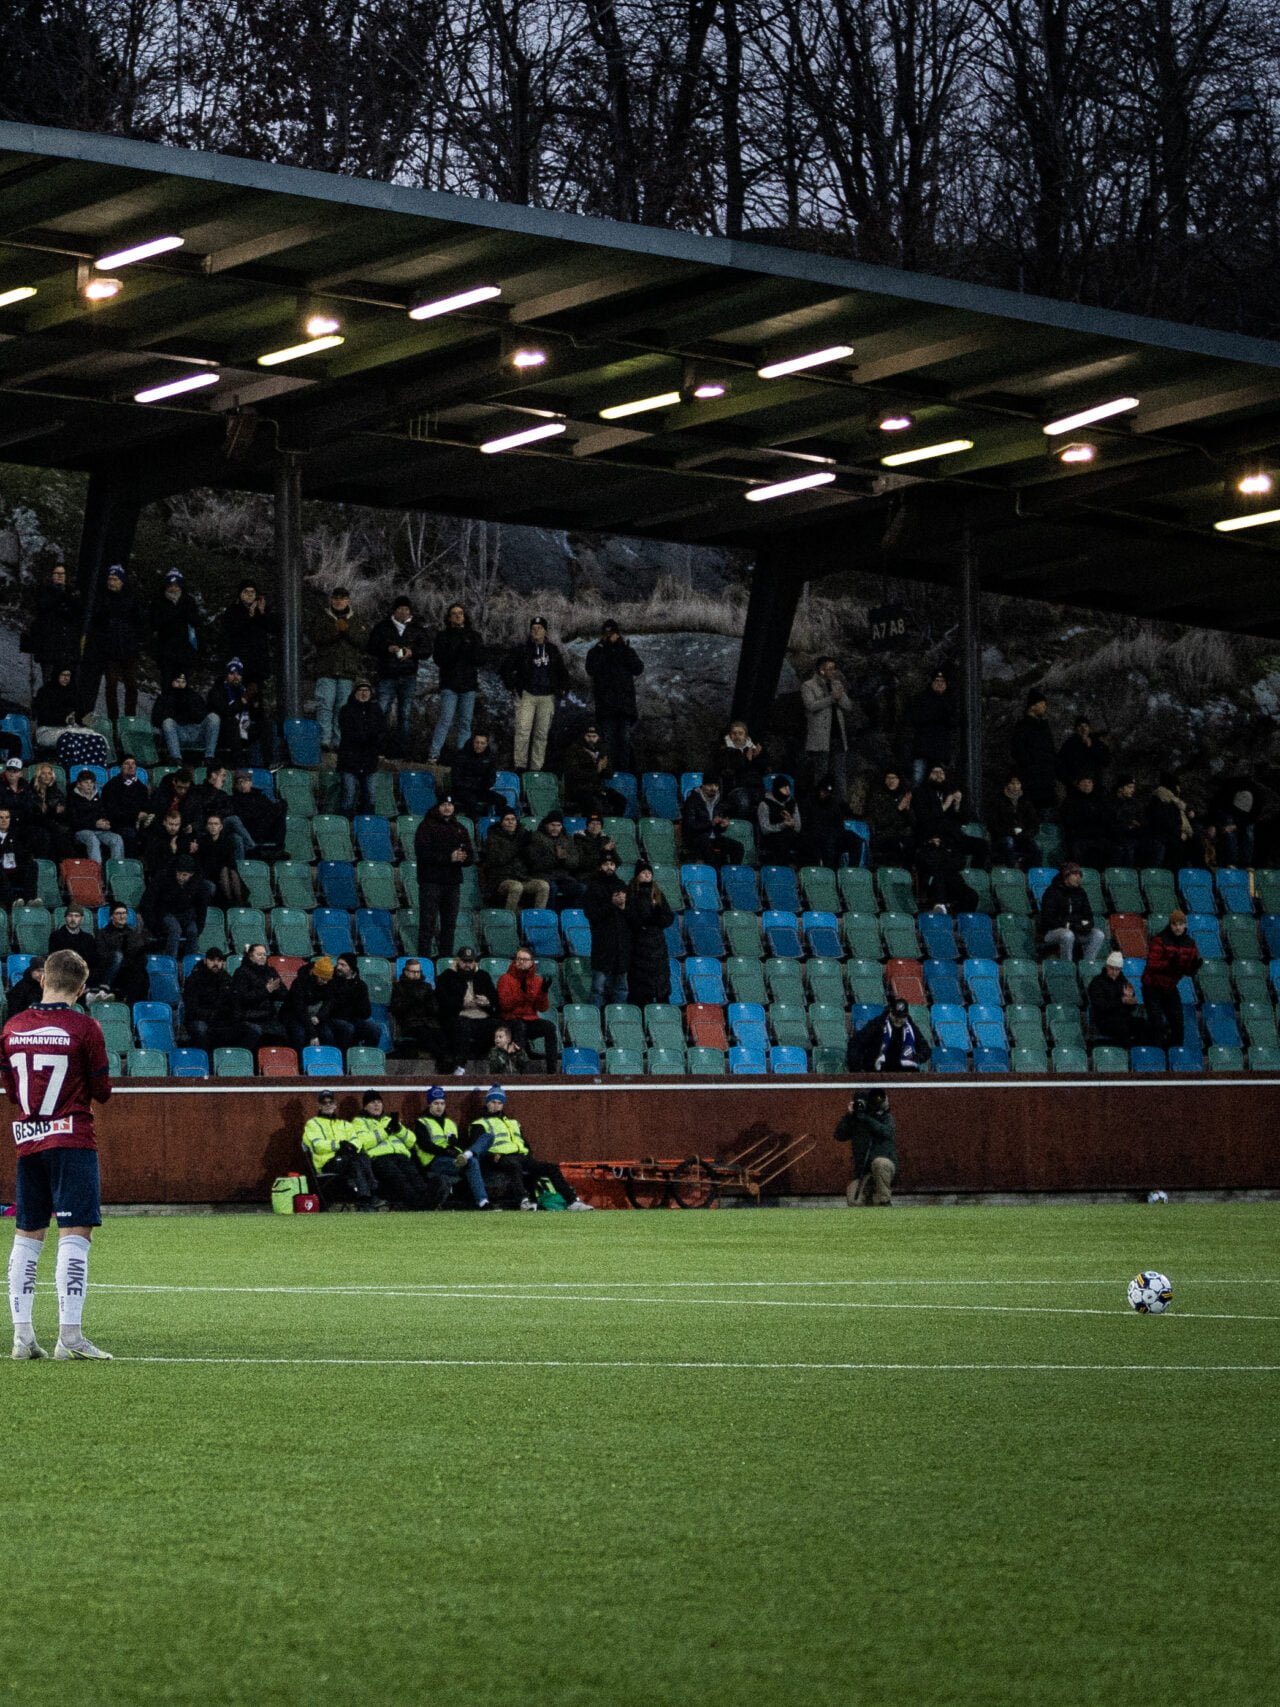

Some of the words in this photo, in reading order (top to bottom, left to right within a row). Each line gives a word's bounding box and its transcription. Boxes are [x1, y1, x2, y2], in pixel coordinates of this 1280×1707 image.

[872, 622, 887, 640] A7
[9, 1036, 71, 1046] HAMMARVIKEN
[9, 1052, 69, 1116] 17
[14, 1120, 52, 1141] BESAB
[23, 1260, 38, 1294] MIKE
[67, 1258, 86, 1297] MIKE
